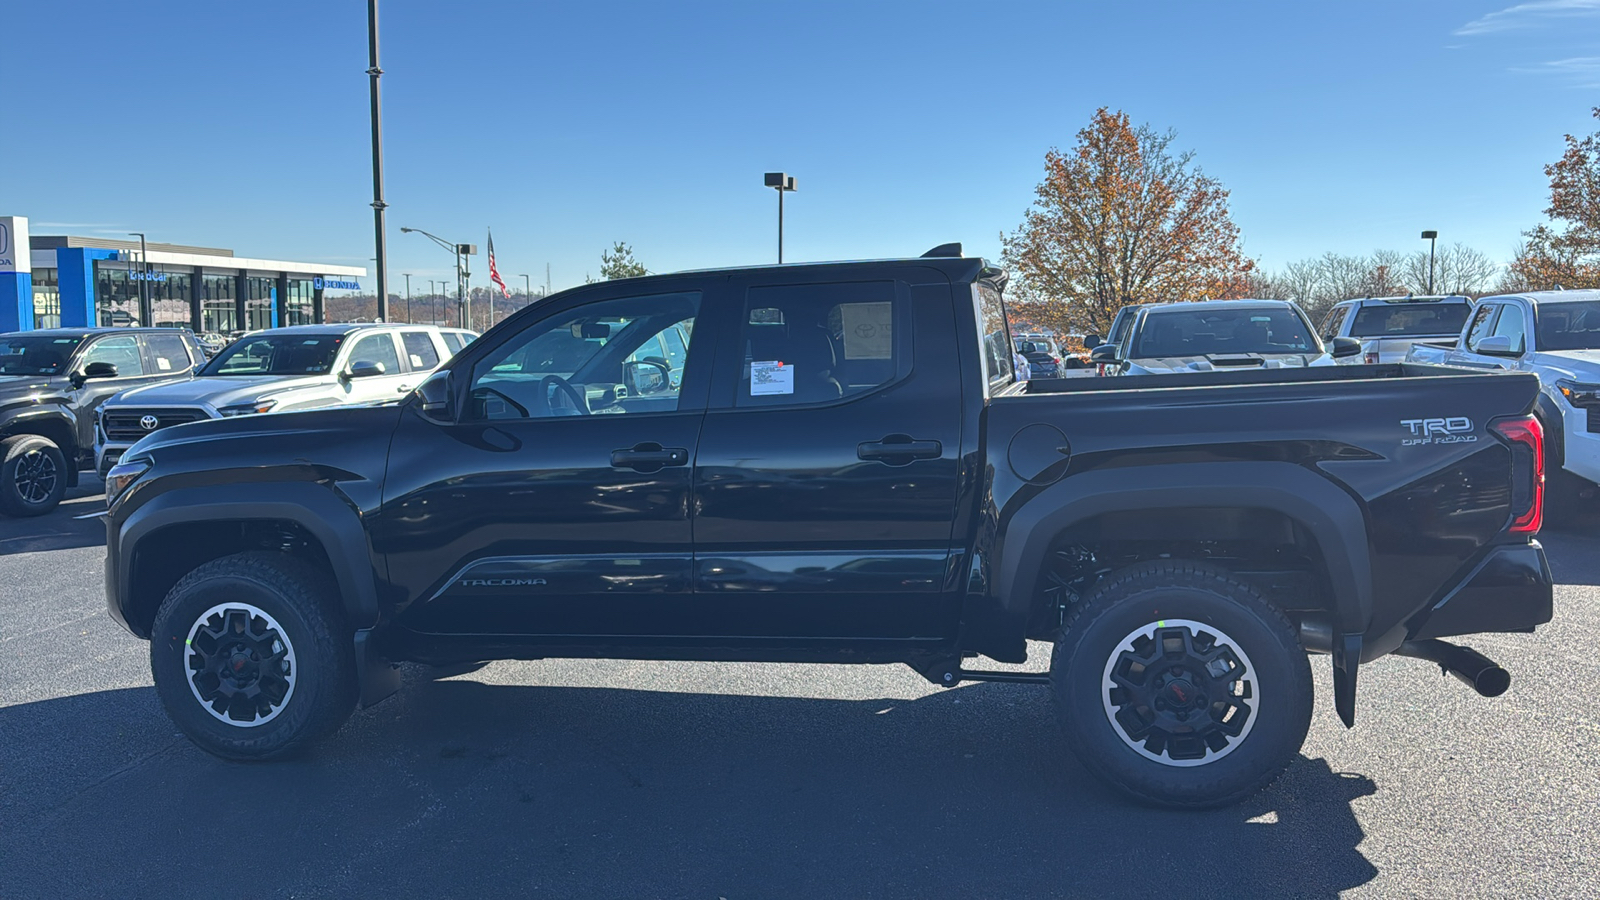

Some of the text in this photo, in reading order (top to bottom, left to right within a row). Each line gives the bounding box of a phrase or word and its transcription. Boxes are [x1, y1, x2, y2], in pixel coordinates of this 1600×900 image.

[1400, 417, 1474, 437] TRD
[1401, 435, 1478, 446] OFF ROAD
[459, 578, 547, 587] TACOMA
